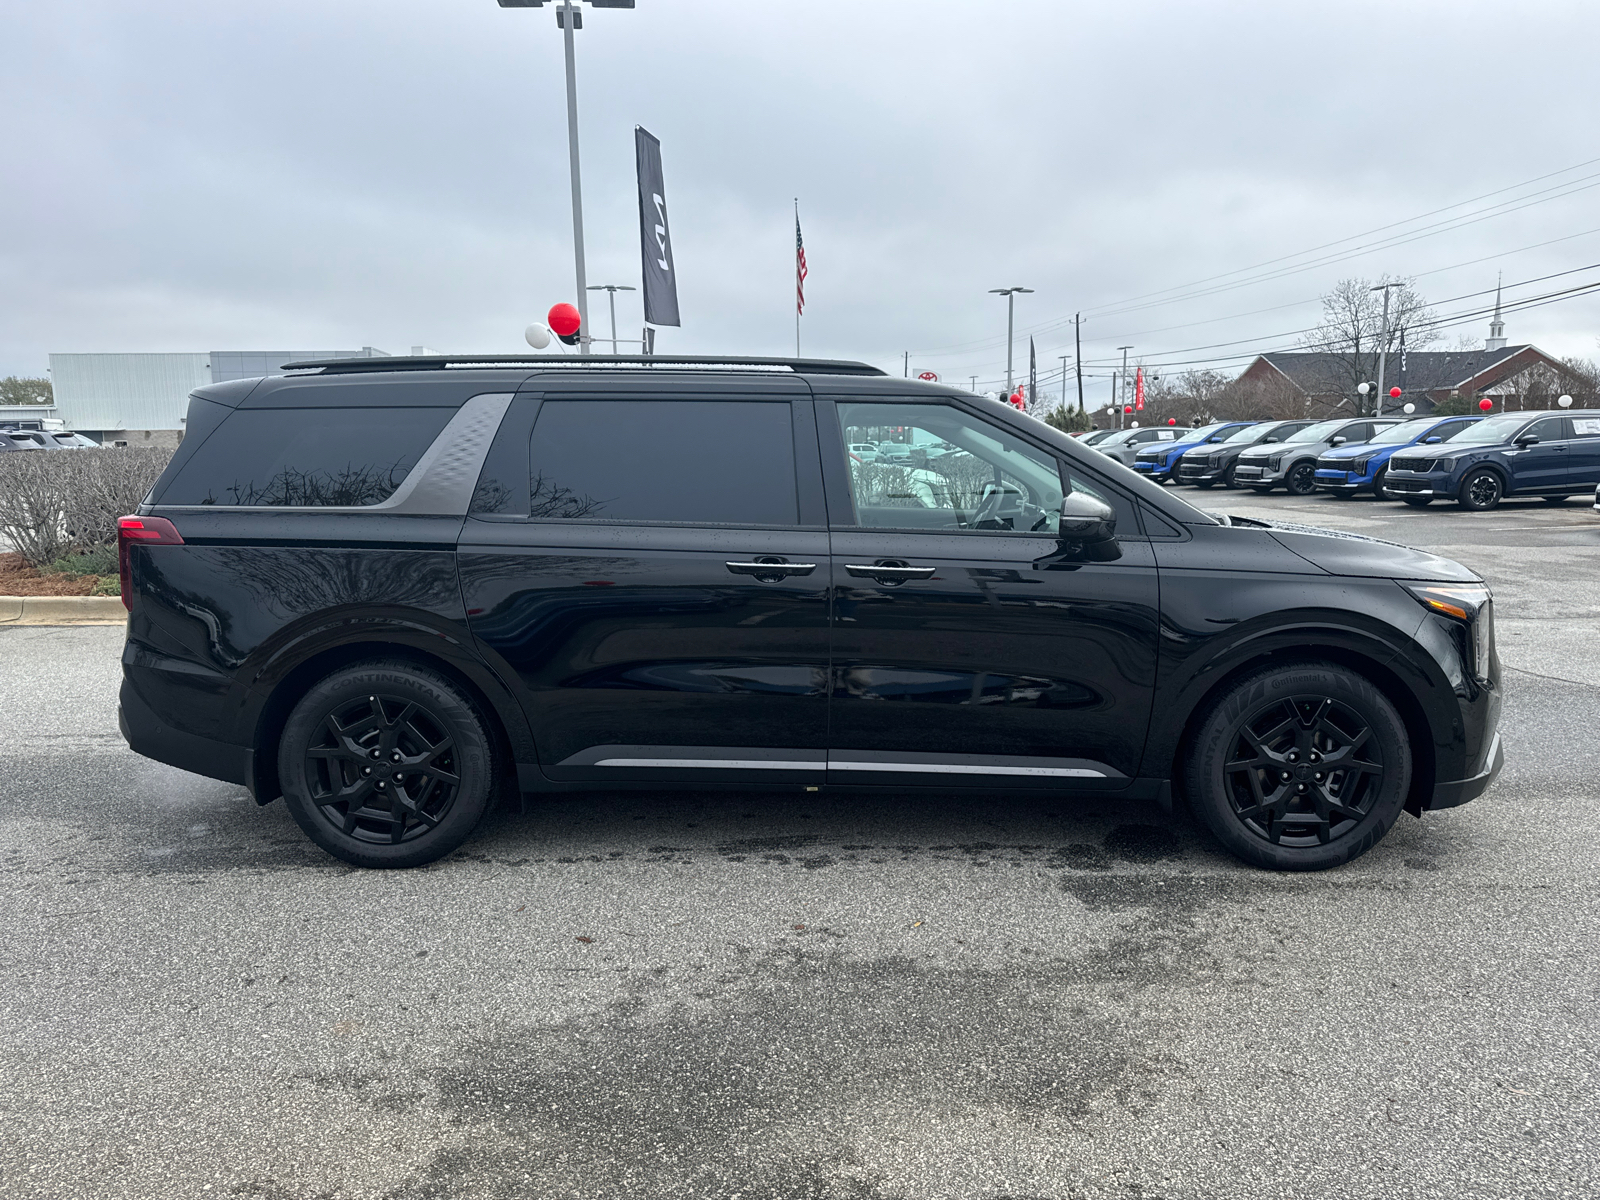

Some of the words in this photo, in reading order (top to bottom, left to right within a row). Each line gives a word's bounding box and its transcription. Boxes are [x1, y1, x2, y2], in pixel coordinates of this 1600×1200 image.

[652, 193, 669, 271] KIA
[330, 674, 442, 704] CONTINENTAL
[1271, 674, 1320, 689] Continental
